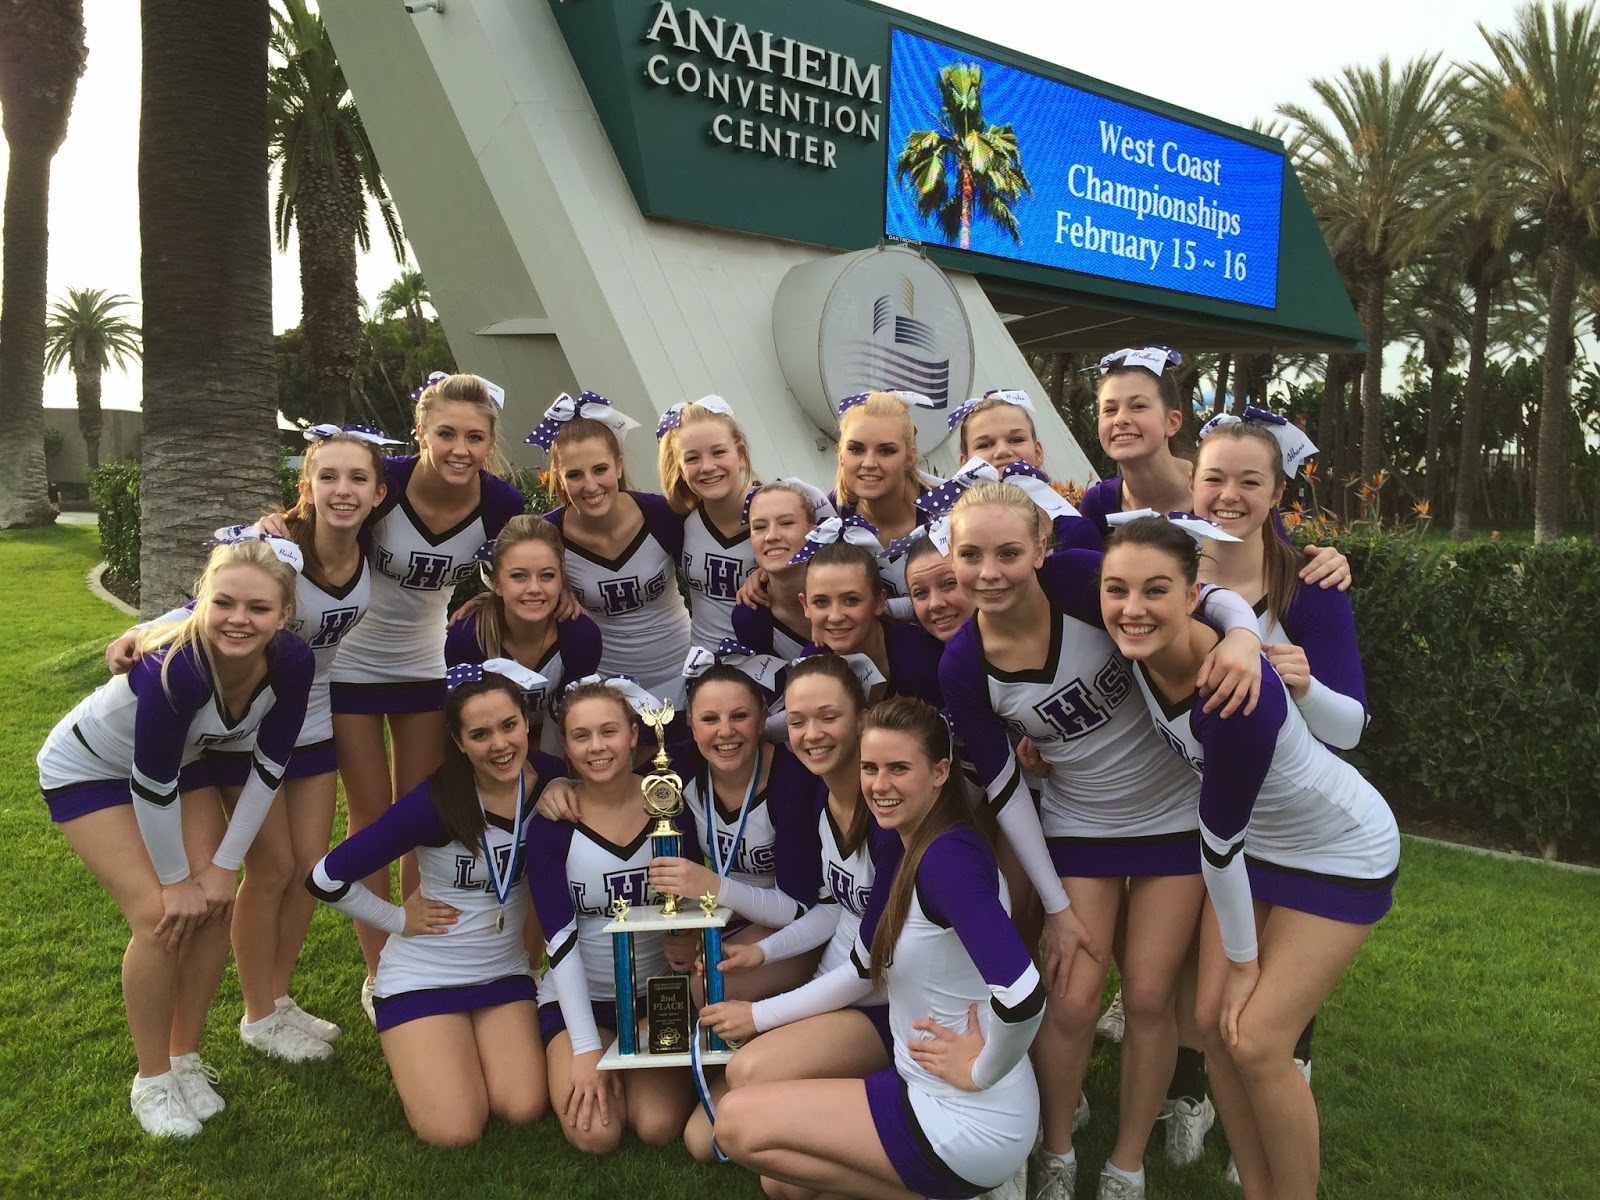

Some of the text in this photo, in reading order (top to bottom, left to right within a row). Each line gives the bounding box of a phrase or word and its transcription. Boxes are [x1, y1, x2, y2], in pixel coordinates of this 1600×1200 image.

[646, 1, 882, 103] ANAHEIM
[647, 55, 880, 142] CONVENTION
[712, 114, 837, 168] CENTER
[1099, 120, 1221, 186] West Coast
[1068, 164, 1241, 240] Championships
[1055, 210, 1164, 270] February
[1172, 238, 1197, 271] 15
[1224, 250, 1247, 282] 16
[684, 552, 758, 602] LH
[570, 866, 672, 918] LH
[653, 1002, 684, 1011] PLACE
[660, 993, 676, 1002] 2nd
